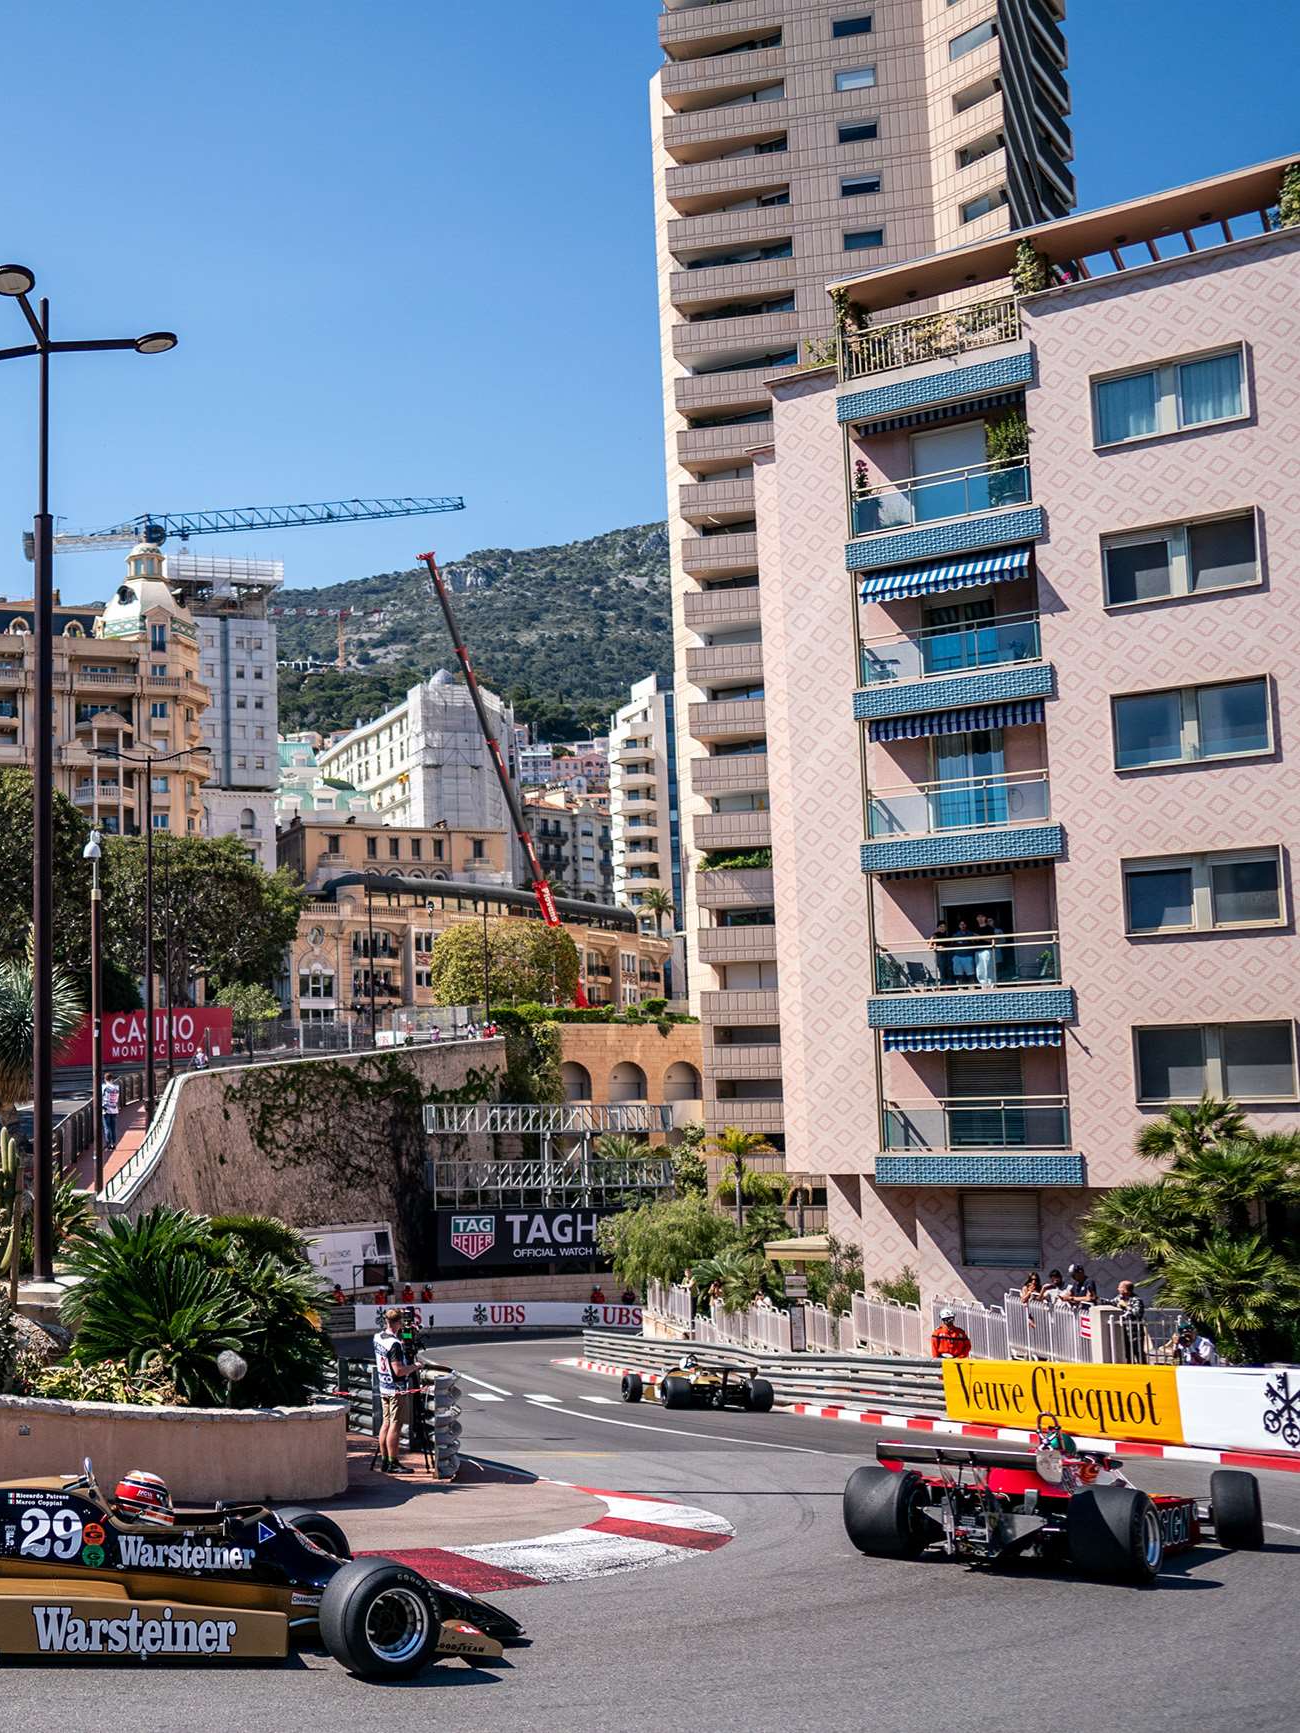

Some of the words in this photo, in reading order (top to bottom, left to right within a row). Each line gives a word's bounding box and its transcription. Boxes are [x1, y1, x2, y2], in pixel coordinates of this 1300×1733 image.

[112, 1044, 147, 1057] MONT
[158, 1041, 194, 1054] CRLO
[455, 1219, 491, 1232] TAG
[505, 1214, 597, 1244] TAGH
[453, 1235, 492, 1255] HEUER
[513, 1248, 556, 1258] OFFICIAL
[559, 1247, 593, 1256] WATCH
[490, 1304, 526, 1324] UBS
[602, 1306, 643, 1326] UBS
[956, 1362, 1026, 1414] Veuve
[1031, 1366, 1162, 1433] Clicquot
[38, 1499, 63, 1507] Coppini
[20, 1508, 83, 1559] 29
[117, 1535, 256, 1570] Warsteiner
[32, 1606, 237, 1653] Warsteiner
